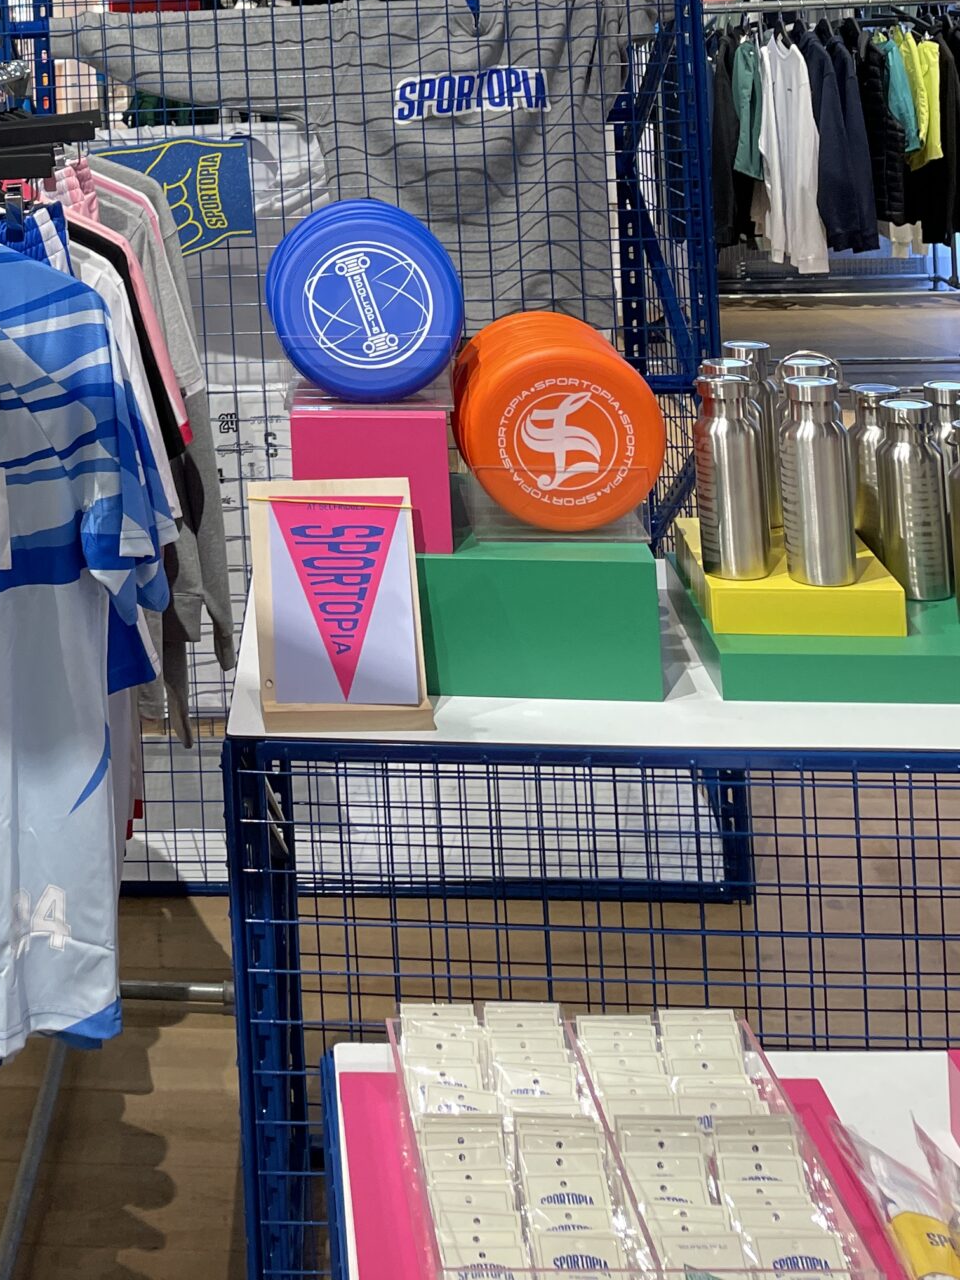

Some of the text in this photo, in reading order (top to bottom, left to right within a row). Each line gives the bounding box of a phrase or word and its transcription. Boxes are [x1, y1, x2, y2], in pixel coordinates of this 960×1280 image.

[397, 67, 549, 121] SPORTOPIA
[196, 152, 228, 229] SPORTOPIA
[498, 390, 531, 470] SPORTOPIA
[534, 377, 620, 411] SPORTOPIA
[512, 471, 597, 506] SPORTOPIA
[602, 413, 635, 494] SPORTOPIA
[290, 524, 386, 656] SPORTOPIA
